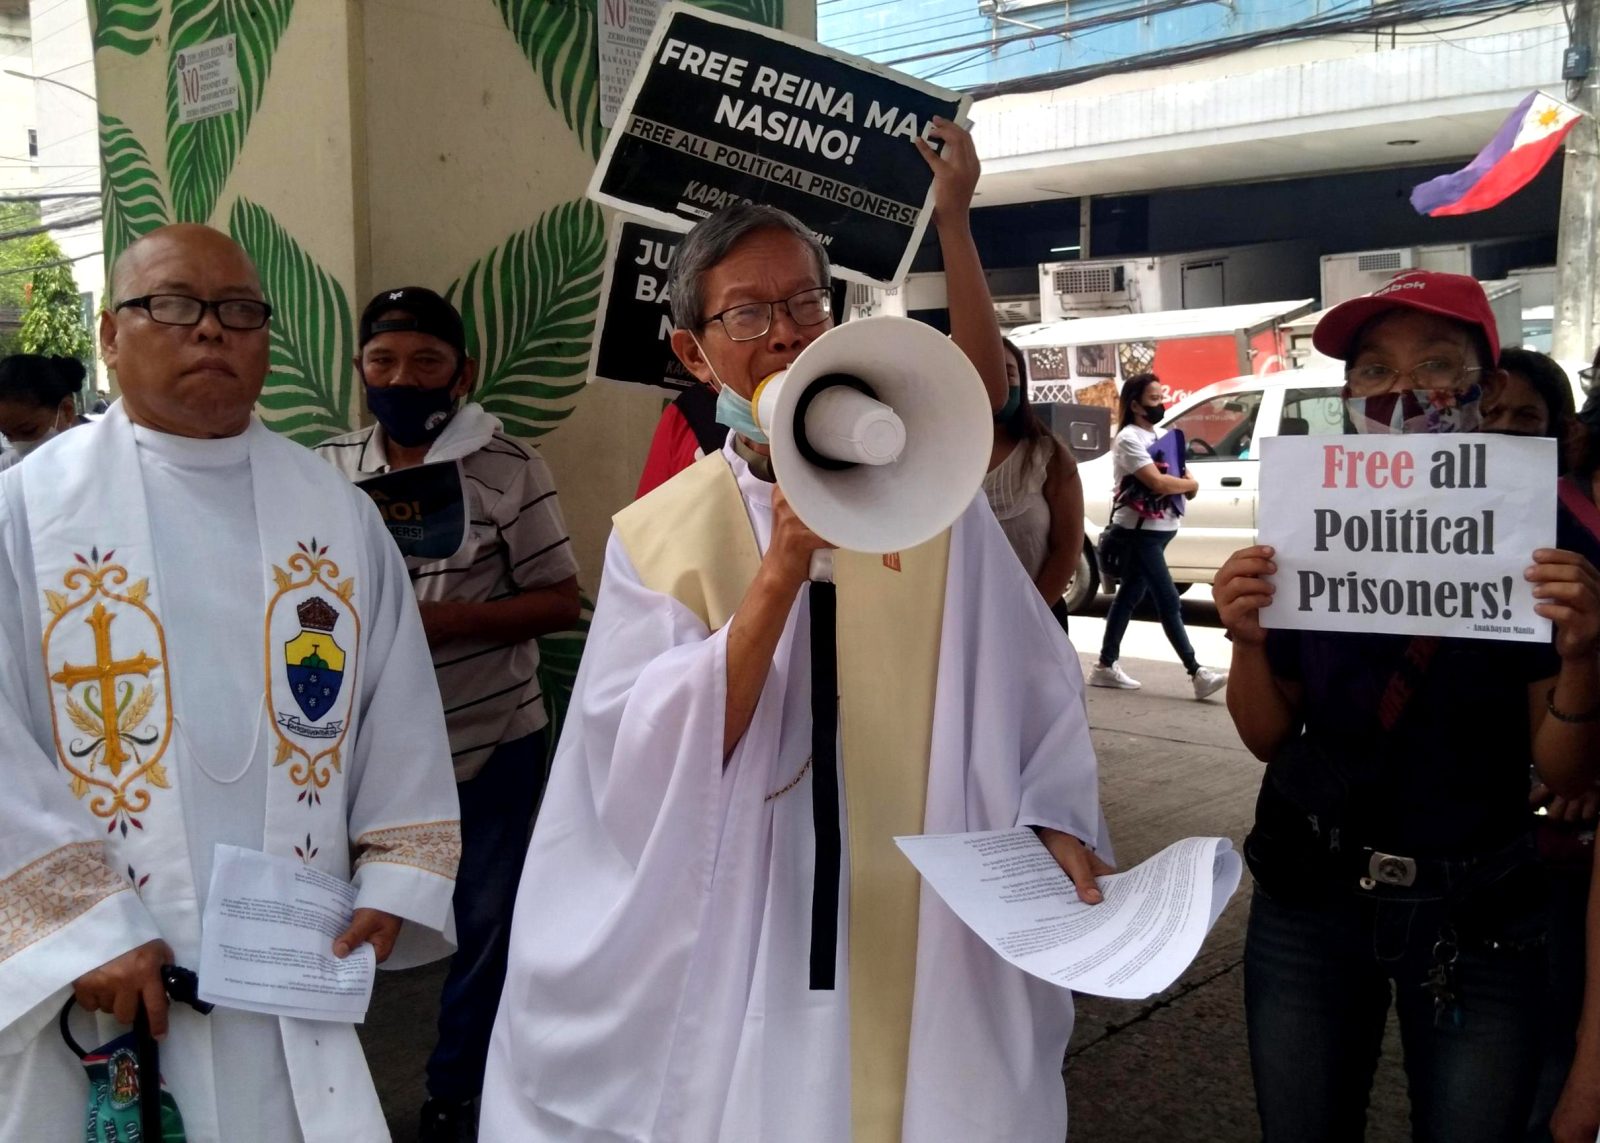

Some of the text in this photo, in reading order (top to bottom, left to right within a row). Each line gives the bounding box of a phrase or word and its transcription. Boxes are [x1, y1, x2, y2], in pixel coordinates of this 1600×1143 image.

[603, 0, 627, 29] NO
[182, 67, 200, 105] NO
[659, 38, 940, 150] FREE REINA MAE
[713, 95, 861, 165] NASINO!
[630, 117, 919, 227] FREE ALL POLITICAL PRISONERS!
[1321, 443, 1487, 489] Free all
[1313, 508, 1494, 555] Political
[1297, 570, 1513, 620] Prisoners!
[1474, 624, 1511, 633] Anakbayan
[1513, 626, 1535, 635] Manila
